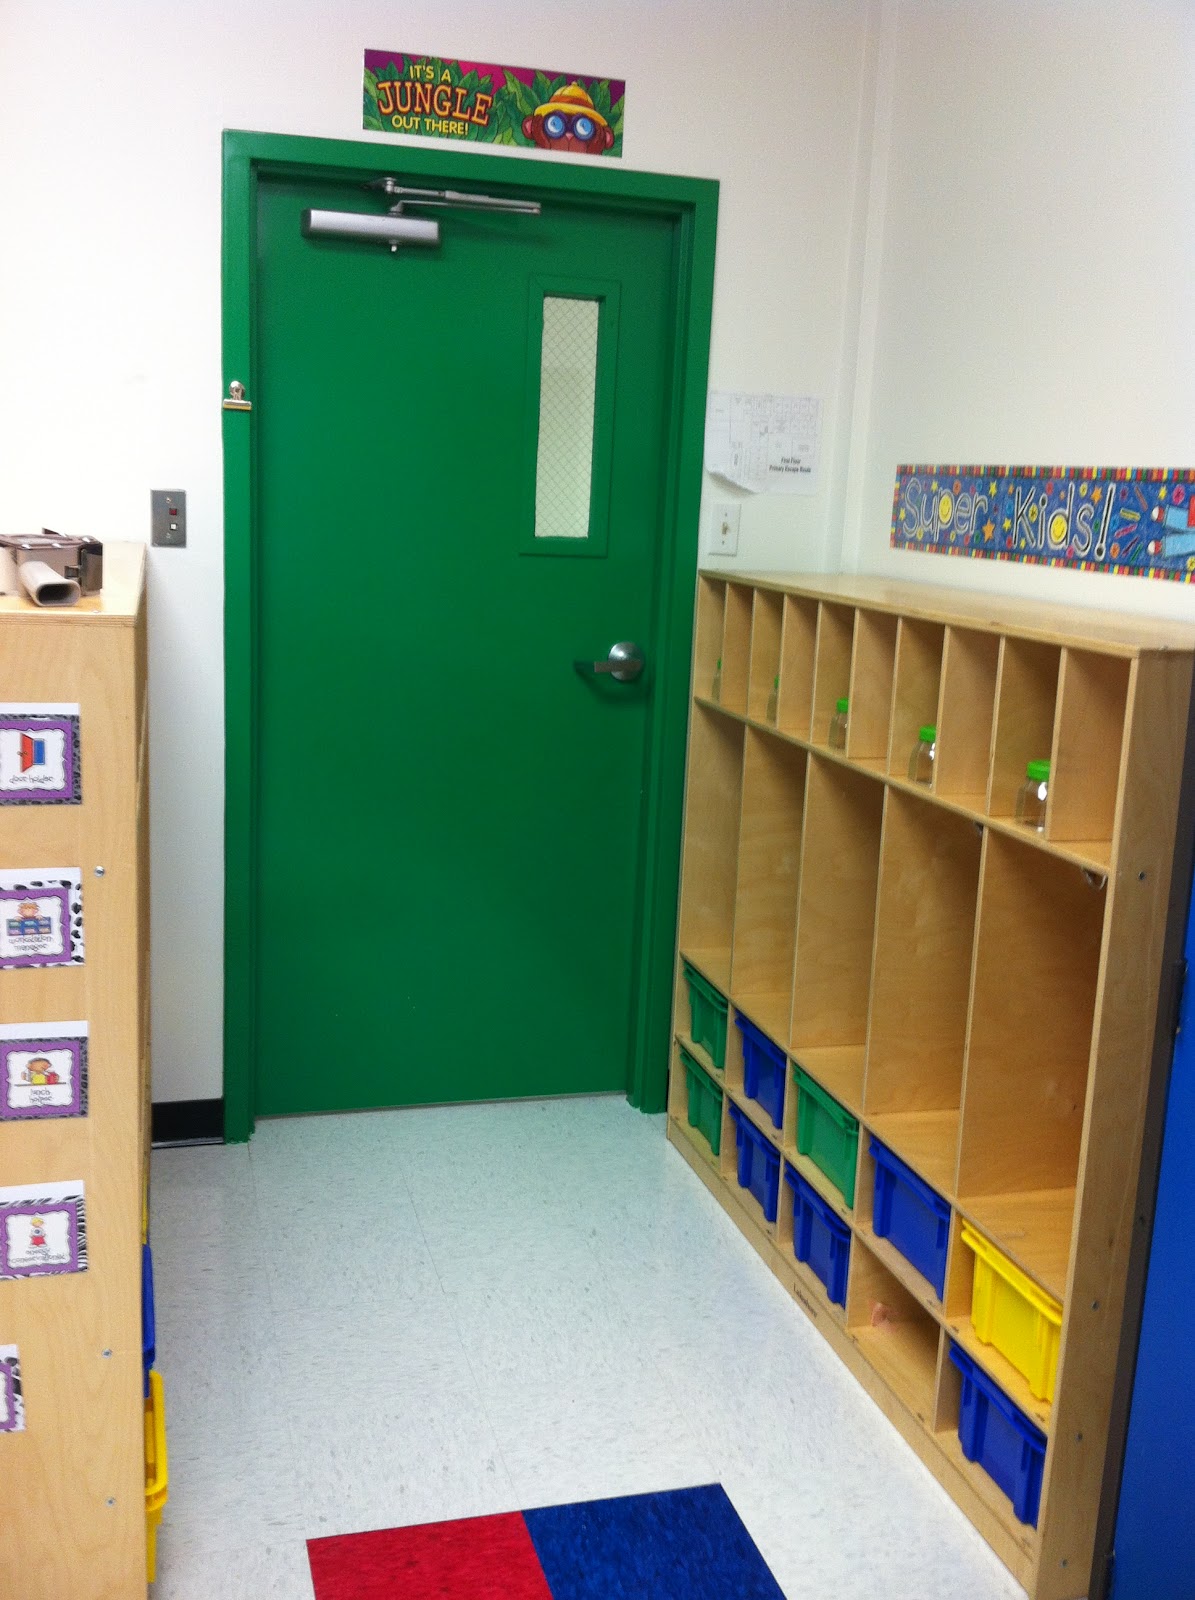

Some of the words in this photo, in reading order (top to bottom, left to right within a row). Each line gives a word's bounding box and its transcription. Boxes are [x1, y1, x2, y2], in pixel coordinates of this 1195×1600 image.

[409, 65, 435, 80] IT'S
[441, 69, 451, 82] A
[377, 81, 493, 126] JUNGLE
[391, 115, 421, 129] OUT
[424, 118, 469, 135] THERE!
[902, 477, 989, 542] Super
[1013, 482, 1117, 561] Kids!
